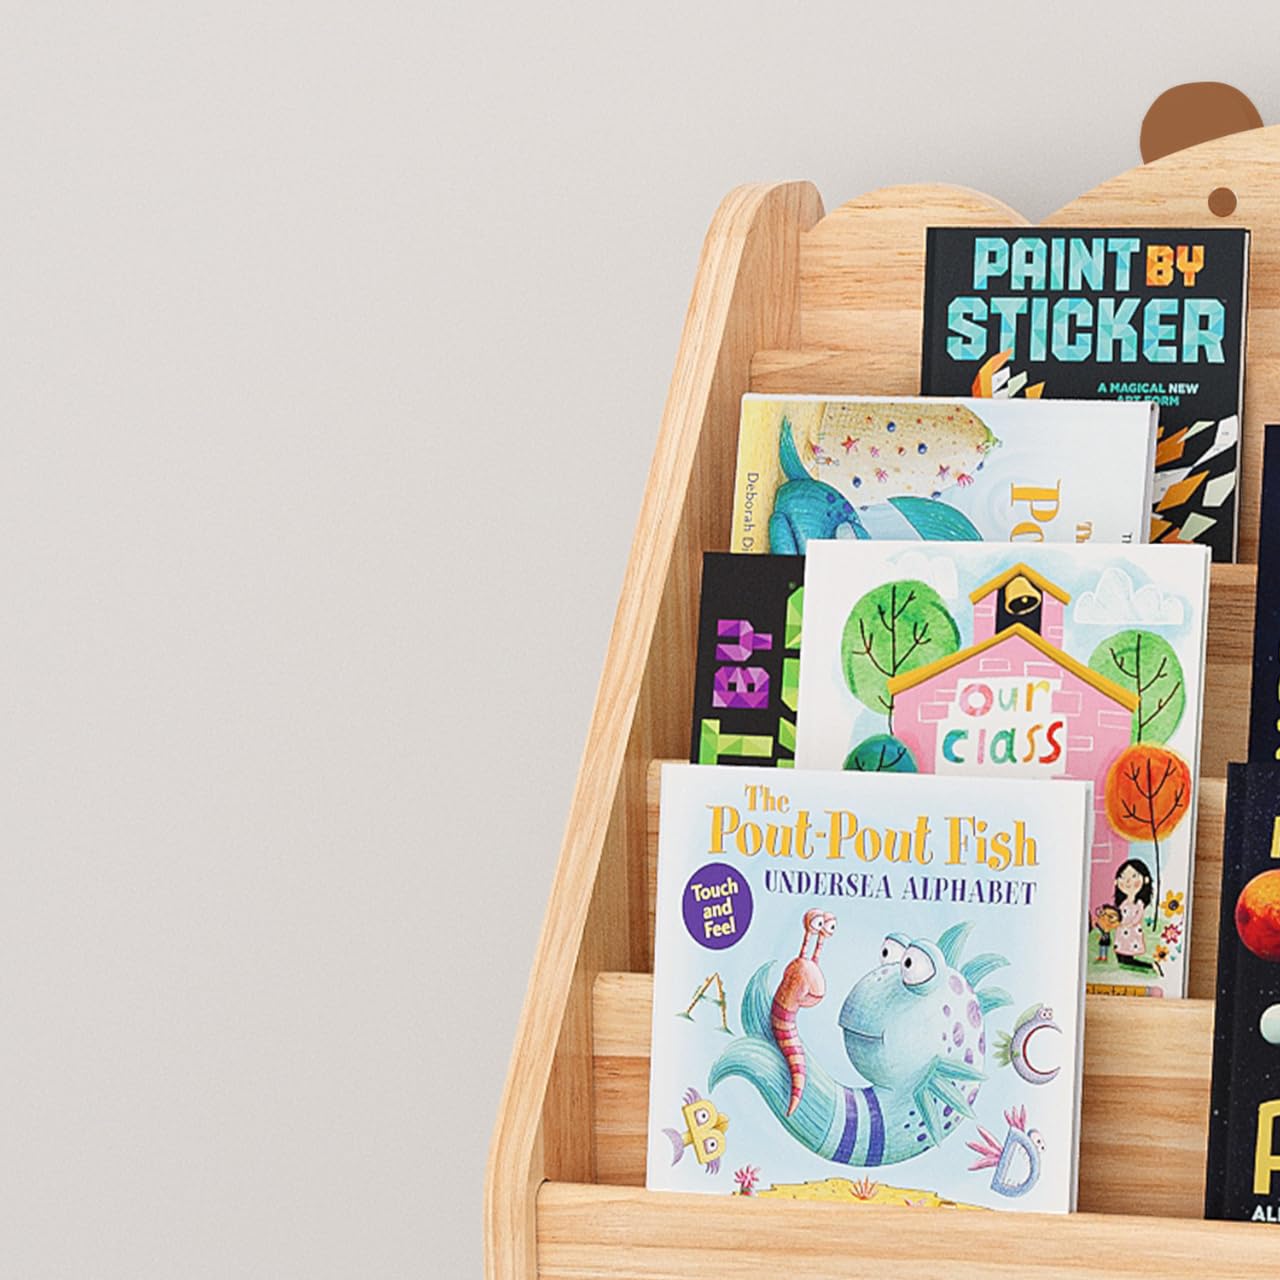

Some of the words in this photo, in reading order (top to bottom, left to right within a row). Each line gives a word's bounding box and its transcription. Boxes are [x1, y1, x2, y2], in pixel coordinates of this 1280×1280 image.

[973, 237, 1141, 292] PAINT
[1145, 245, 1205, 287] BY
[946, 296, 1226, 364] STICKER
[1097, 382, 1108, 394] A
[1109, 382, 1166, 394] MAGICAL
[1168, 383, 1200, 395] NEW
[743, 472, 760, 532] Deborah
[713, 619, 773, 709] BY
[959, 680, 1051, 717] our
[942, 721, 1064, 765] class
[744, 784, 790, 814] The
[705, 804, 933, 865] Pout-Pout
[944, 816, 1040, 872] Fish
[690, 876, 739, 902] Touch
[765, 869, 893, 899] UNDERSEA
[901, 876, 1038, 905] ALPHABET
[703, 896, 733, 919] and
[704, 915, 736, 938] Feel
